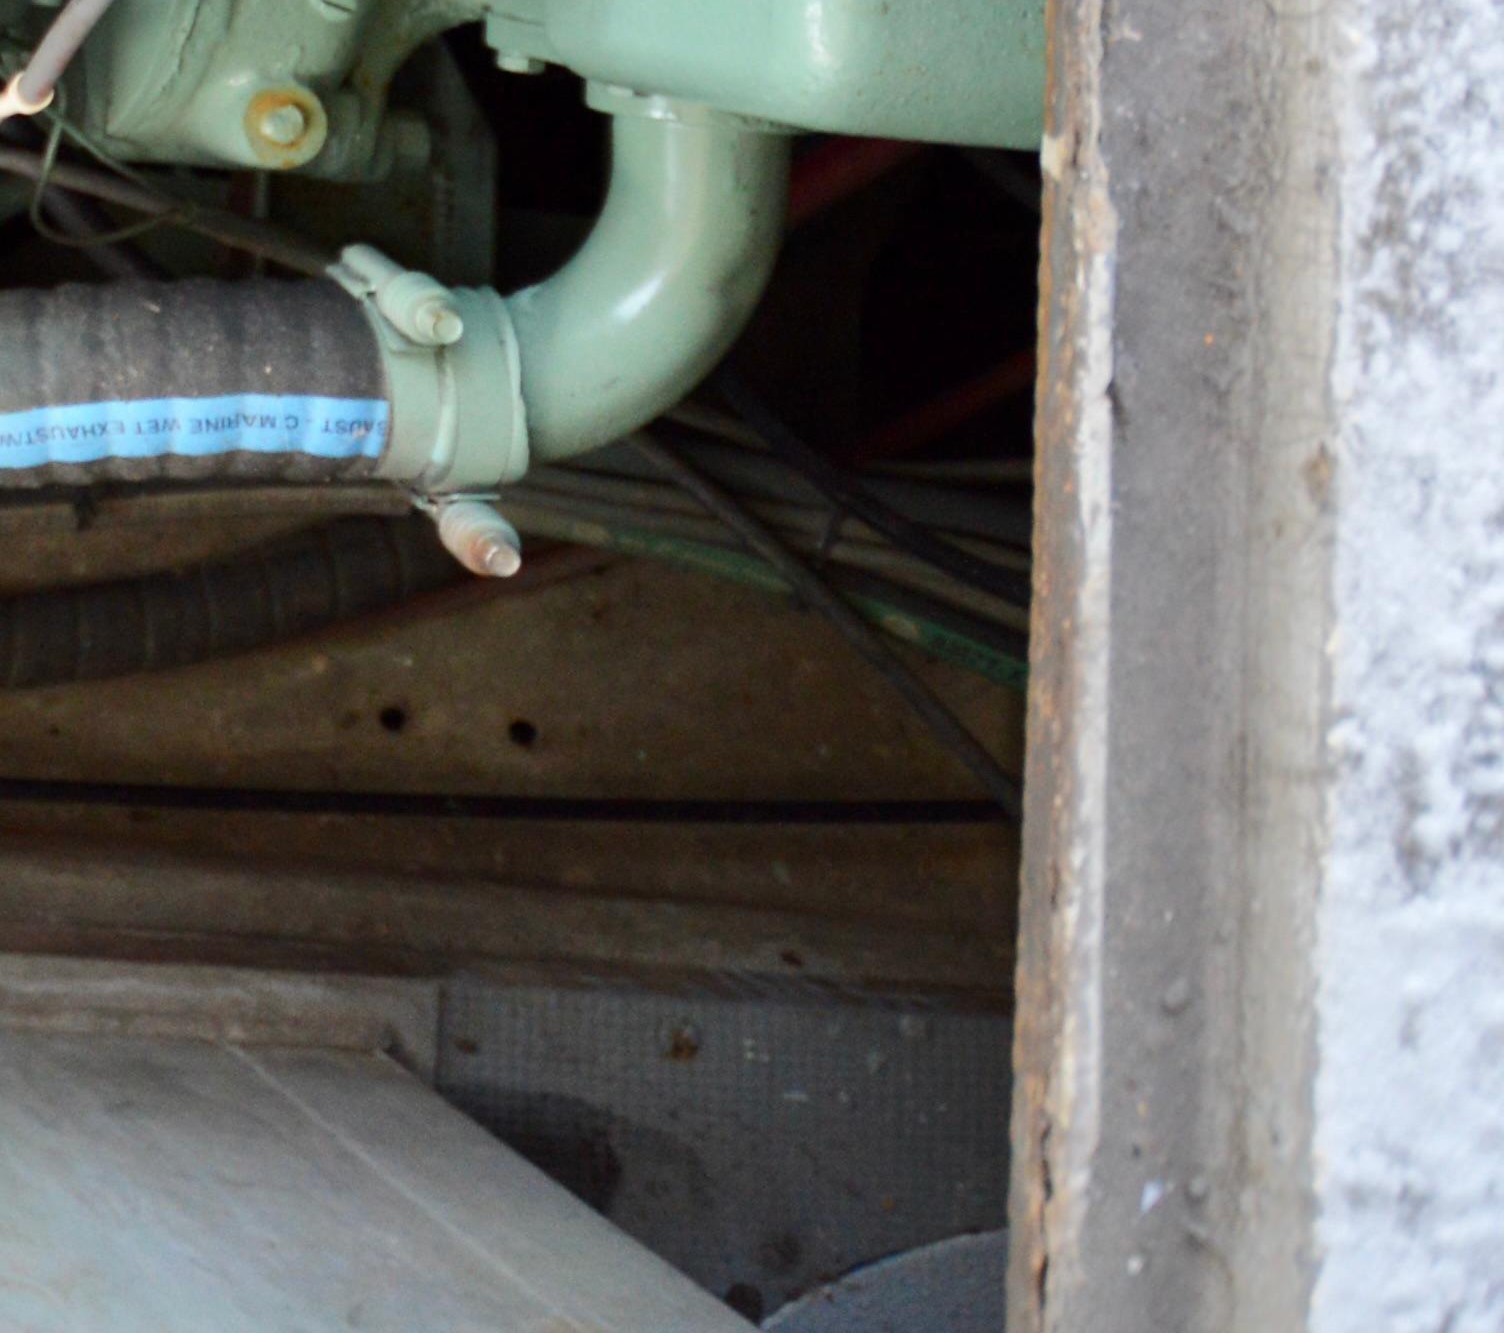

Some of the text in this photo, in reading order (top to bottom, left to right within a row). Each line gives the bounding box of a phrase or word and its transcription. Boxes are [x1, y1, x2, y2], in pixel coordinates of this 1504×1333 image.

[134, 415, 183, 437] WET
[193, 412, 278, 434] MARINE
[284, 414, 300, 431] C
